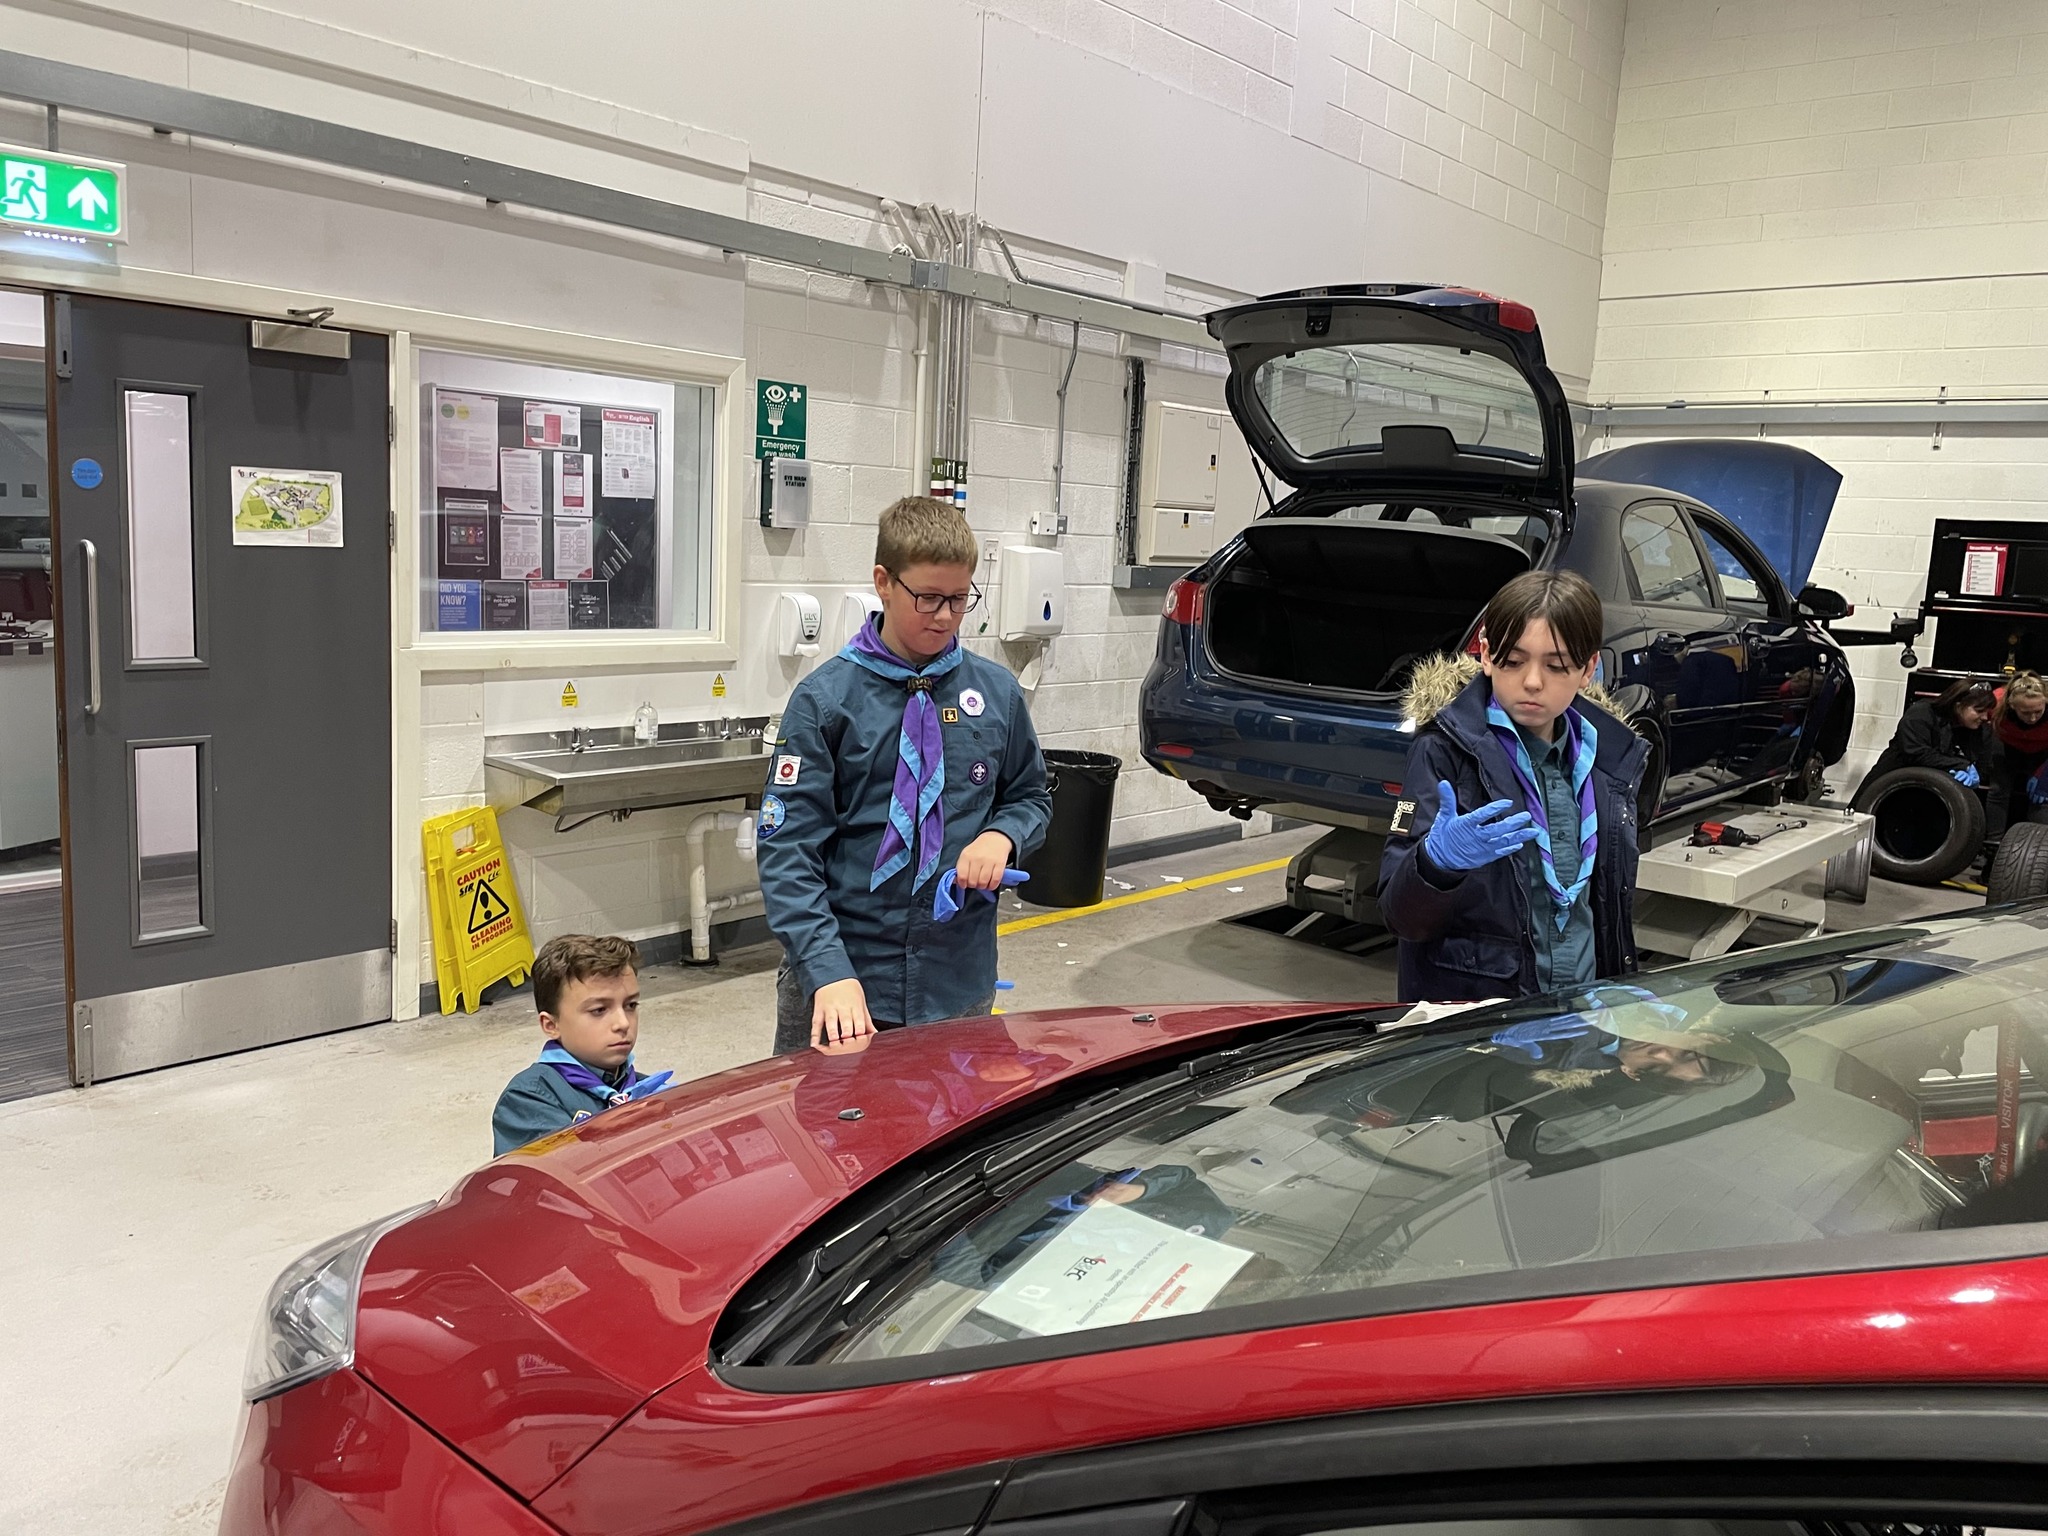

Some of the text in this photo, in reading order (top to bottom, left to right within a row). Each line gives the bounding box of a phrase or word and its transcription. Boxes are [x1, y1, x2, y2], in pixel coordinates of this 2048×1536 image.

[629, 414, 650, 423] English
[762, 439, 800, 453] Emergency
[440, 583, 467, 593] DID YOU
[440, 595, 467, 606] KNOW?
[457, 858, 501, 886] CAUTION
[470, 916, 512, 943] CLEANING
[472, 923, 514, 951] IN PROGRESS
[2001, 1079, 2014, 1129] VISITOR
[1066, 1257, 1098, 1281] B&FC
[1075, 1301, 1103, 1326] Conditioning
